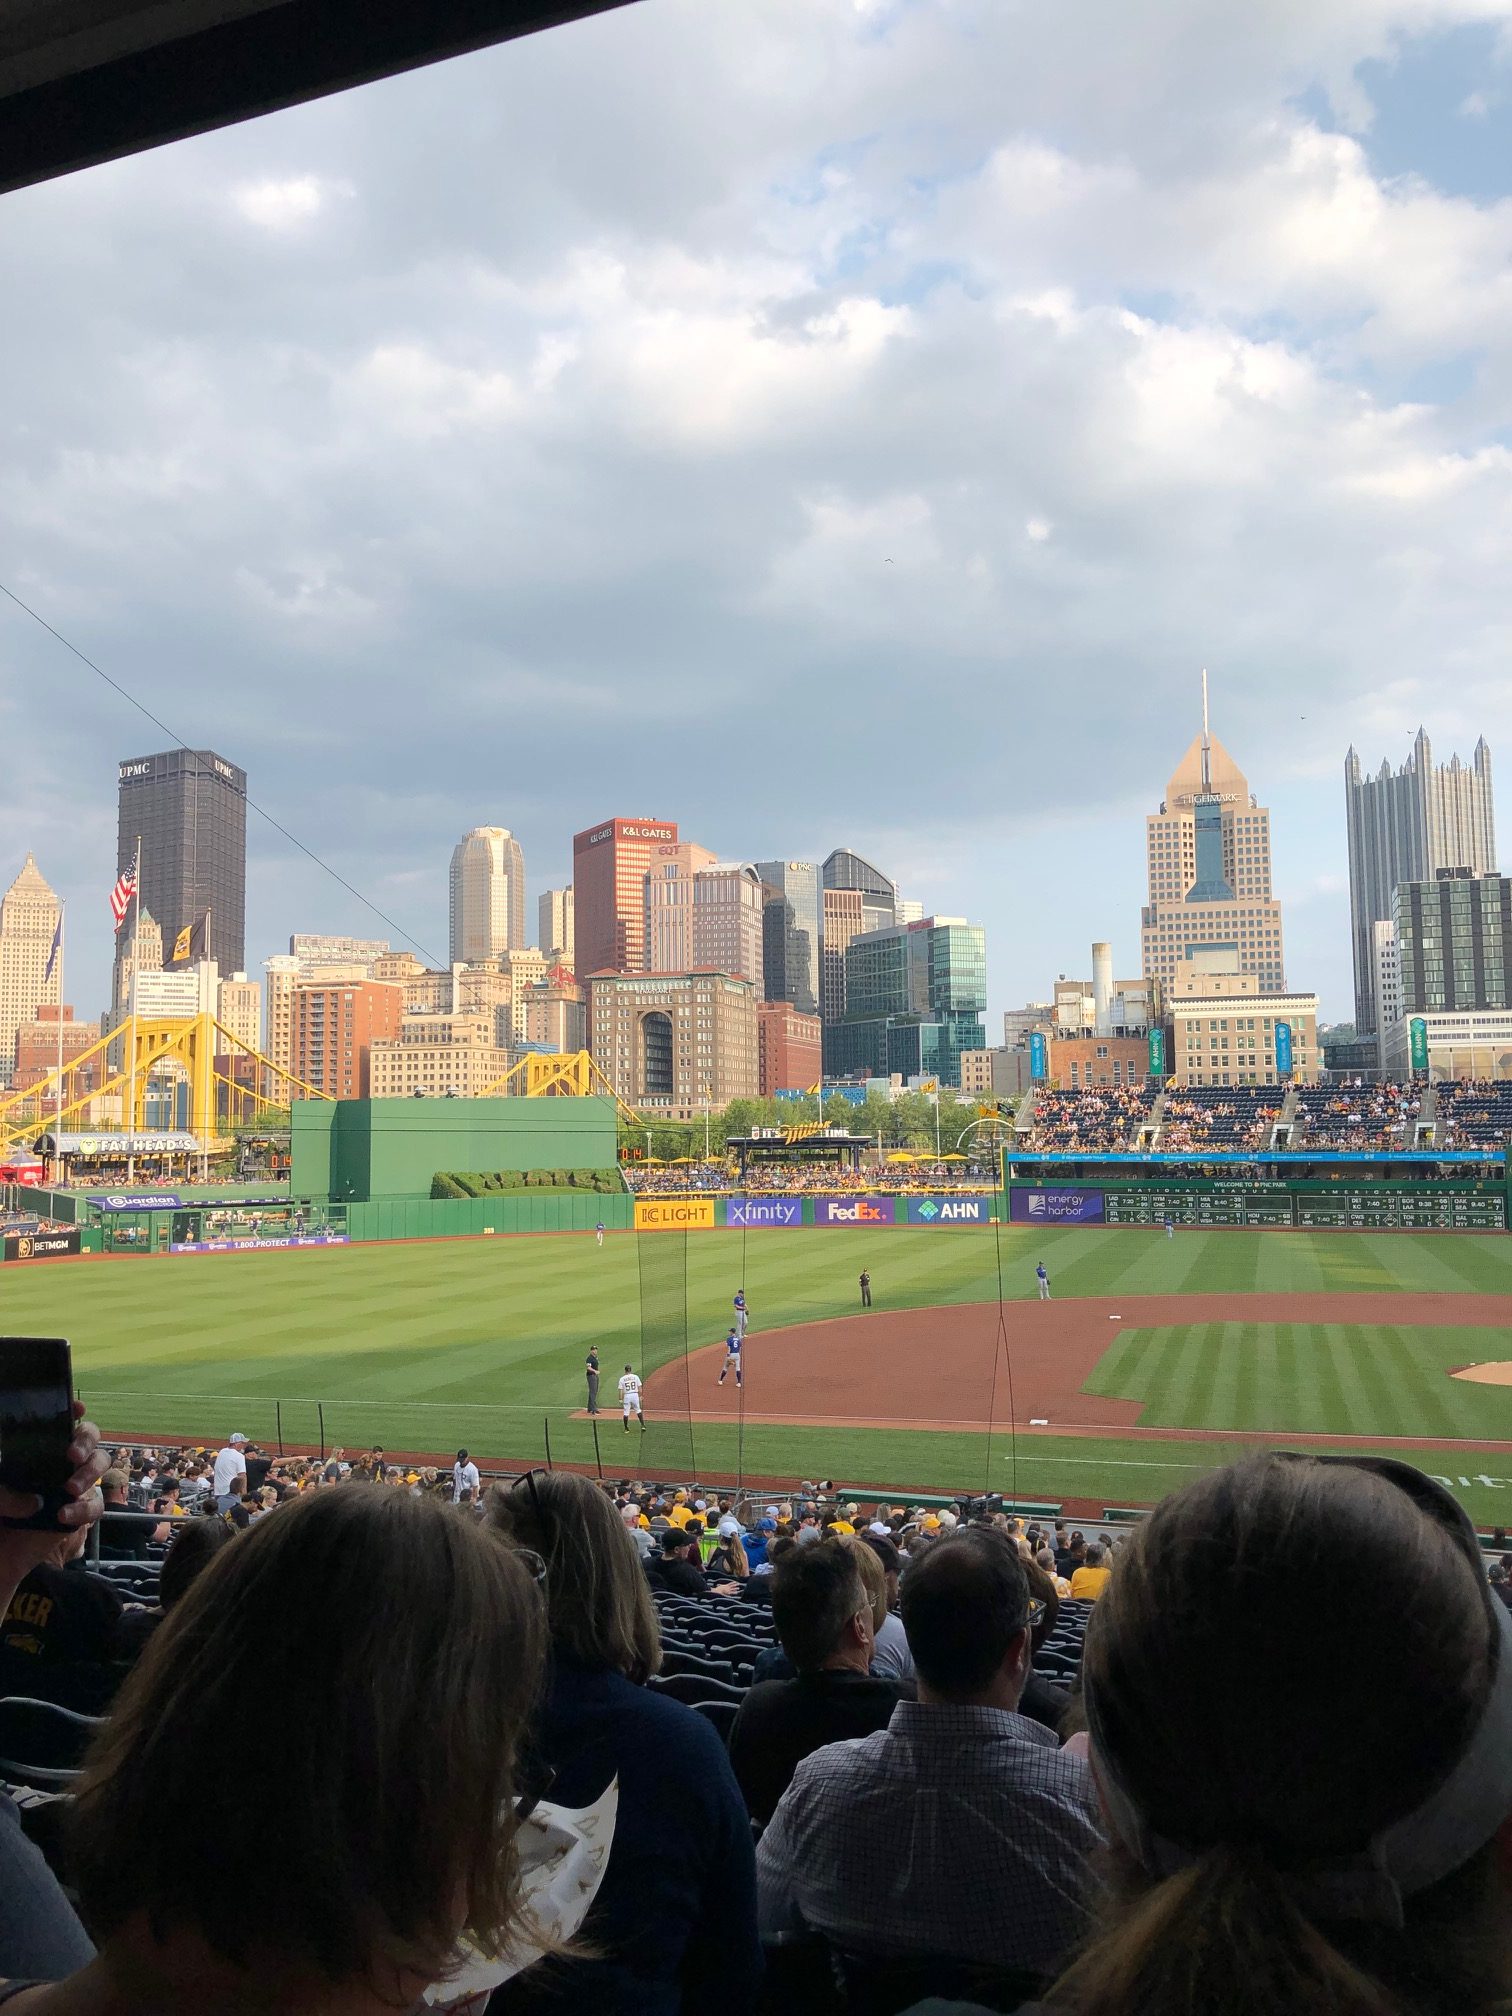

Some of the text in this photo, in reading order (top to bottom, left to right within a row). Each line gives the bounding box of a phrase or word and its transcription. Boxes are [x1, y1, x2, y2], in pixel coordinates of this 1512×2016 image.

[119, 762, 150, 778] UPMC
[215, 760, 233, 780] UPMC
[1184, 792, 1239, 804] HIGHMARK
[590, 827, 613, 844] K&L GATES
[623, 826, 672, 839] K&L GATES
[659, 845, 680, 855] EQT
[798, 863, 812, 872] PNC
[1415, 1029, 1423, 1049] AHN
[824, 1127, 850, 1138] TIME
[100, 1139, 192, 1152] FAT HEAD'S
[106, 1195, 176, 1208] Guardian
[1048, 1195, 1084, 1206] energy
[662, 1207, 708, 1222] LIGHT
[732, 1202, 796, 1224] xfinity
[828, 1202, 881, 1220] FedEx
[940, 1203, 979, 1219] AHN
[1048, 1206, 1084, 1216] harbor
[34, 1240, 69, 1252] BETMGM
[733, 1340, 739, 1348] 6
[624, 1381, 636, 1391] 58
[5, 1592, 54, 1628] KER
